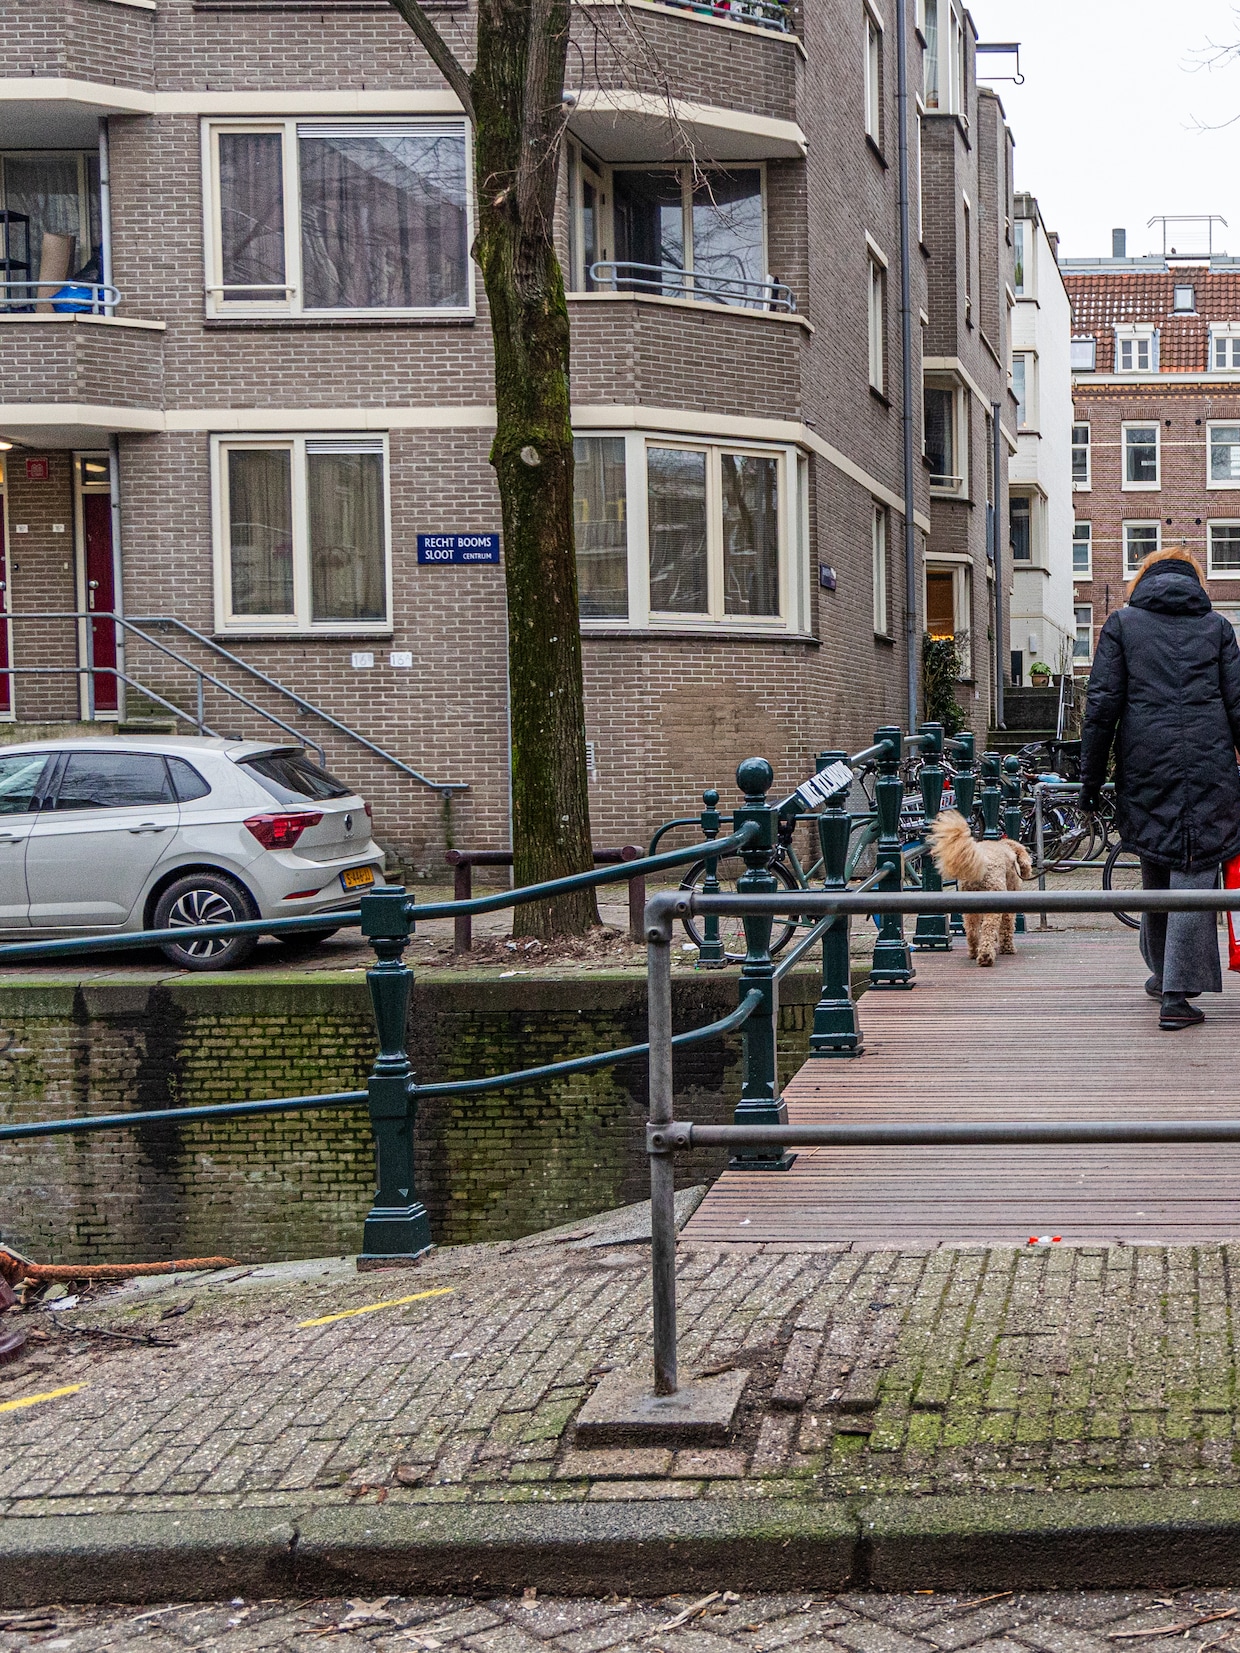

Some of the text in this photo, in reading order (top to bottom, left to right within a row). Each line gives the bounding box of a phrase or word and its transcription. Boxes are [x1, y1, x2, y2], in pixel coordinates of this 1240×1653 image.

[424, 538, 491, 548] RECHT BOOMS
[425, 550, 454, 560] SLOOT
